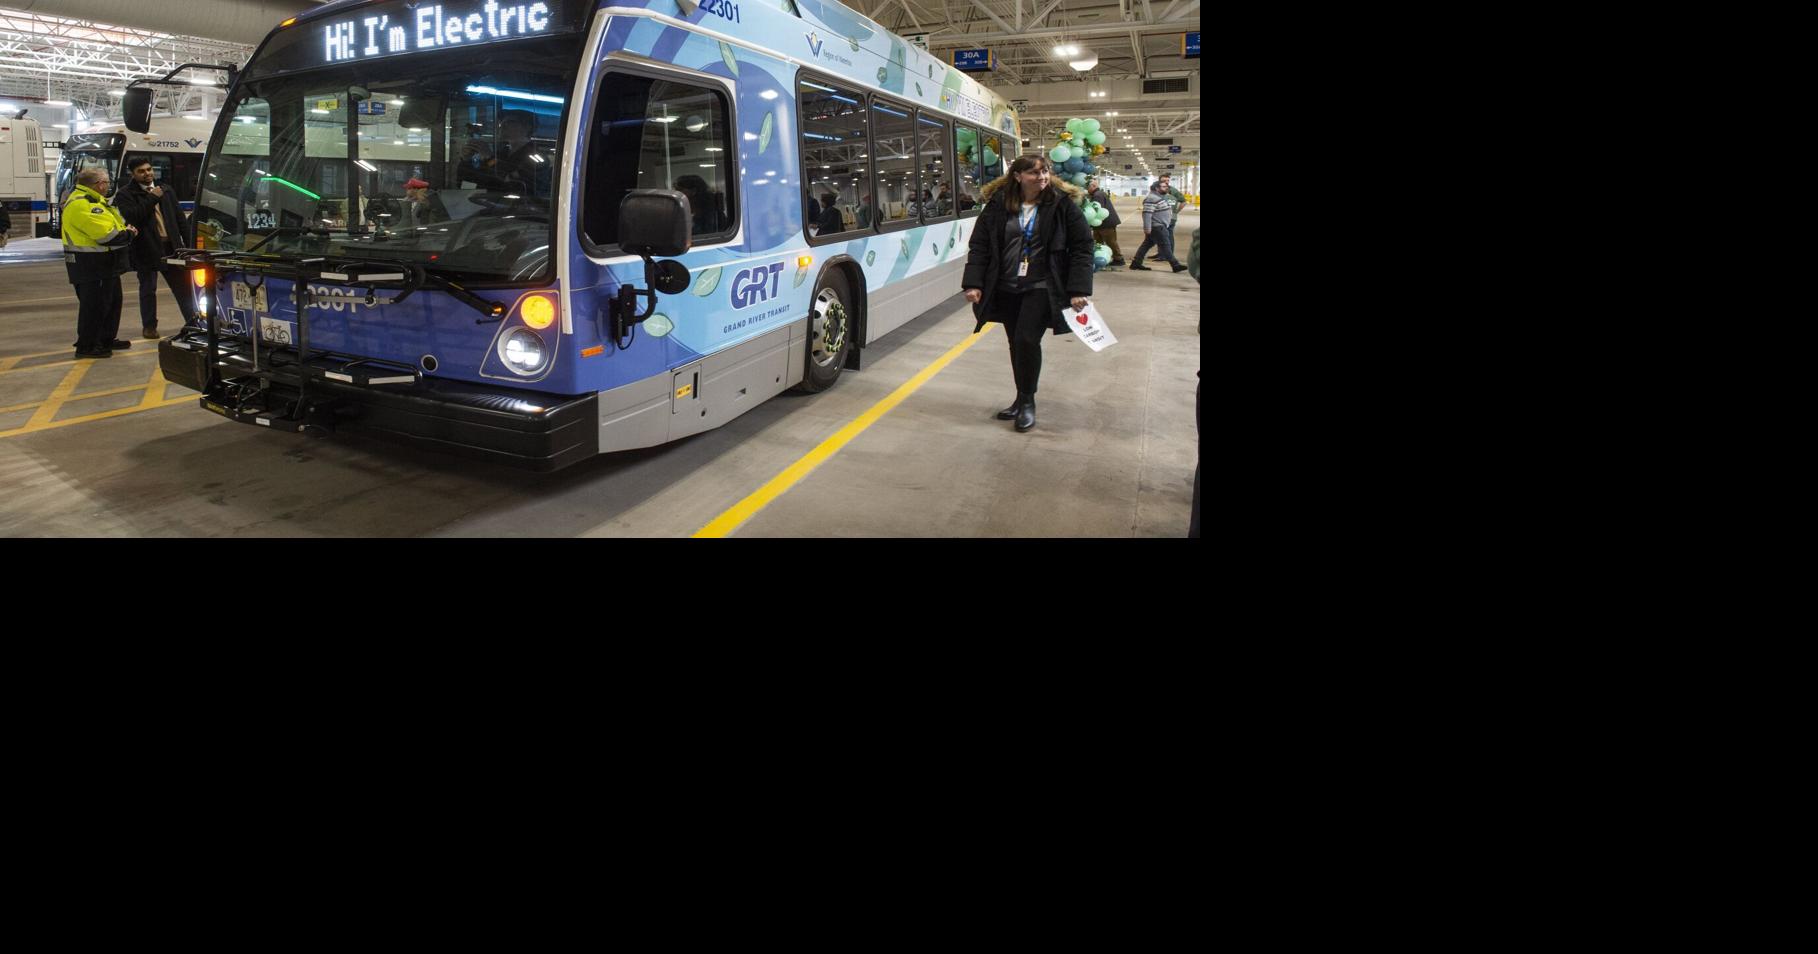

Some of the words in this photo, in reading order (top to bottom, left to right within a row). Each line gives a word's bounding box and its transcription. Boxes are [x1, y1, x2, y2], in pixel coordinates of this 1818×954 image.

[325, 21, 354, 61] Hi!
[364, 15, 406, 55] I'm
[416, 0, 548, 48] Electric
[962, 51, 980, 59] 30A
[157, 140, 179, 148] 21752
[247, 213, 276, 229] 1234
[731, 262, 784, 309] GRT
[723, 320, 746, 333] GRAND
[748, 313, 766, 325] RIVER
[767, 304, 790, 318] TRANSIT
